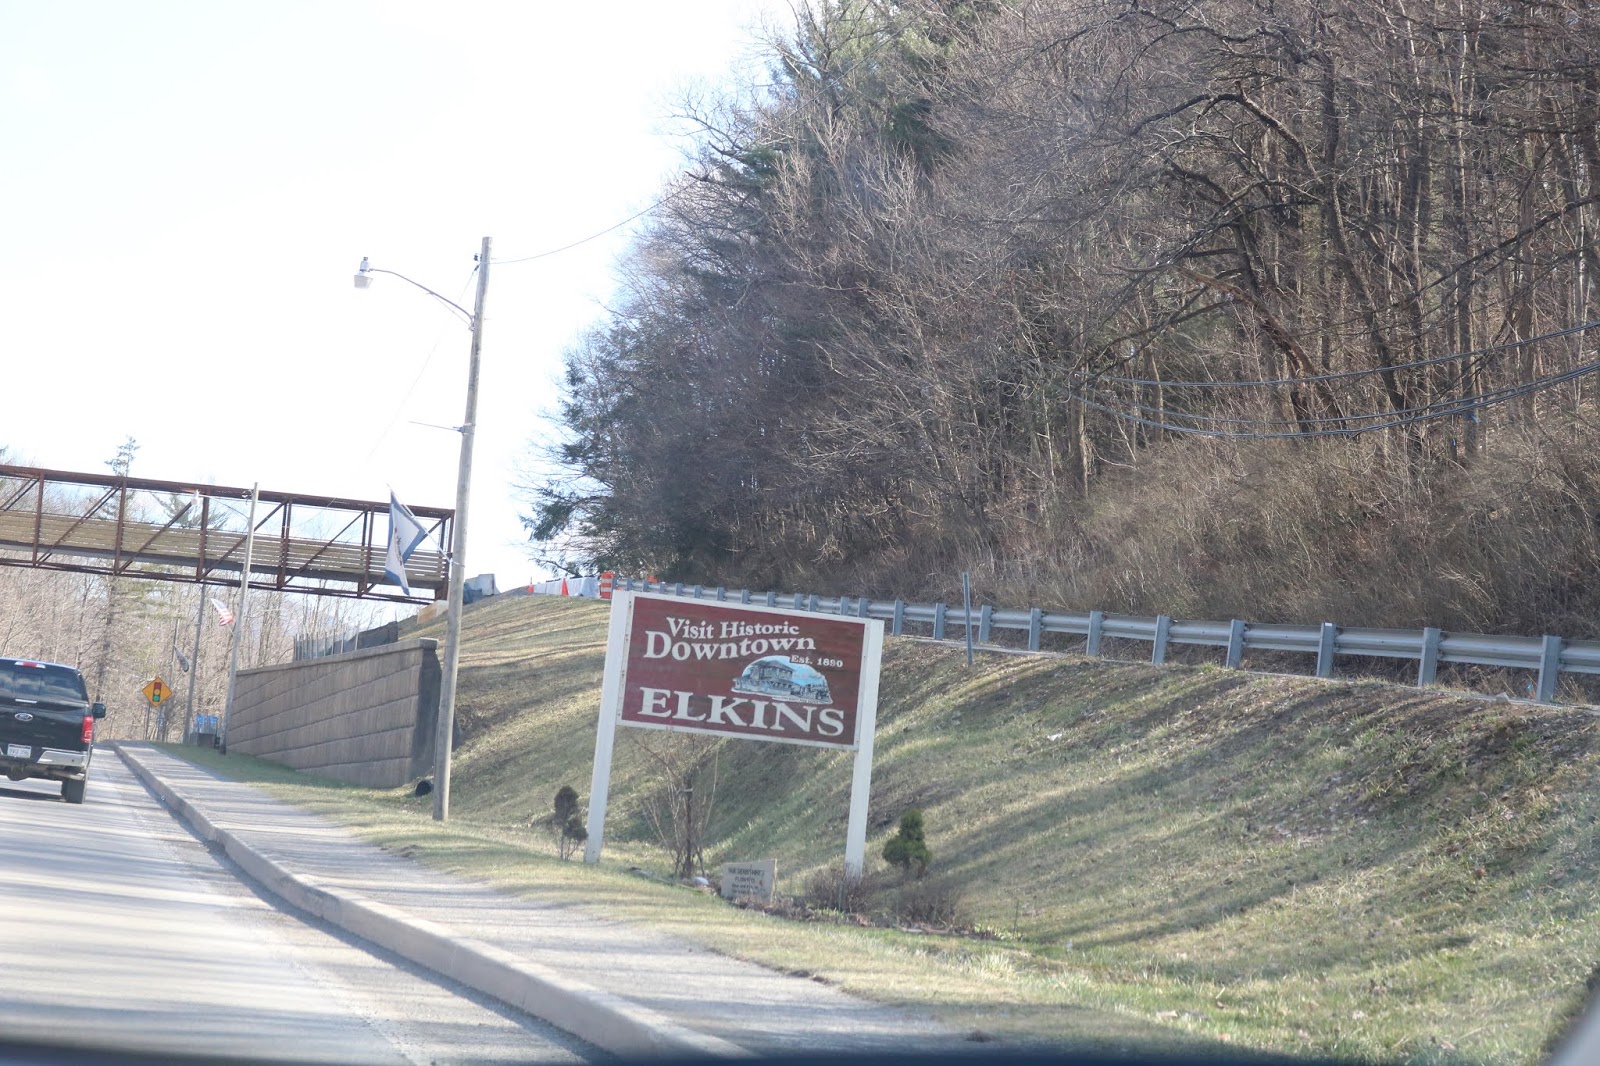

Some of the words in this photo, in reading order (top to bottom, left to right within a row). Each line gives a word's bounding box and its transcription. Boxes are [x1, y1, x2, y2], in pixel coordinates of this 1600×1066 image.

[666, 617, 714, 640] Visit
[720, 621, 799, 640] Historic
[643, 630, 816, 661] Downtown
[791, 654, 813, 665] Est.
[817, 657, 844, 668] 1890
[637, 686, 844, 736] ELKINS
